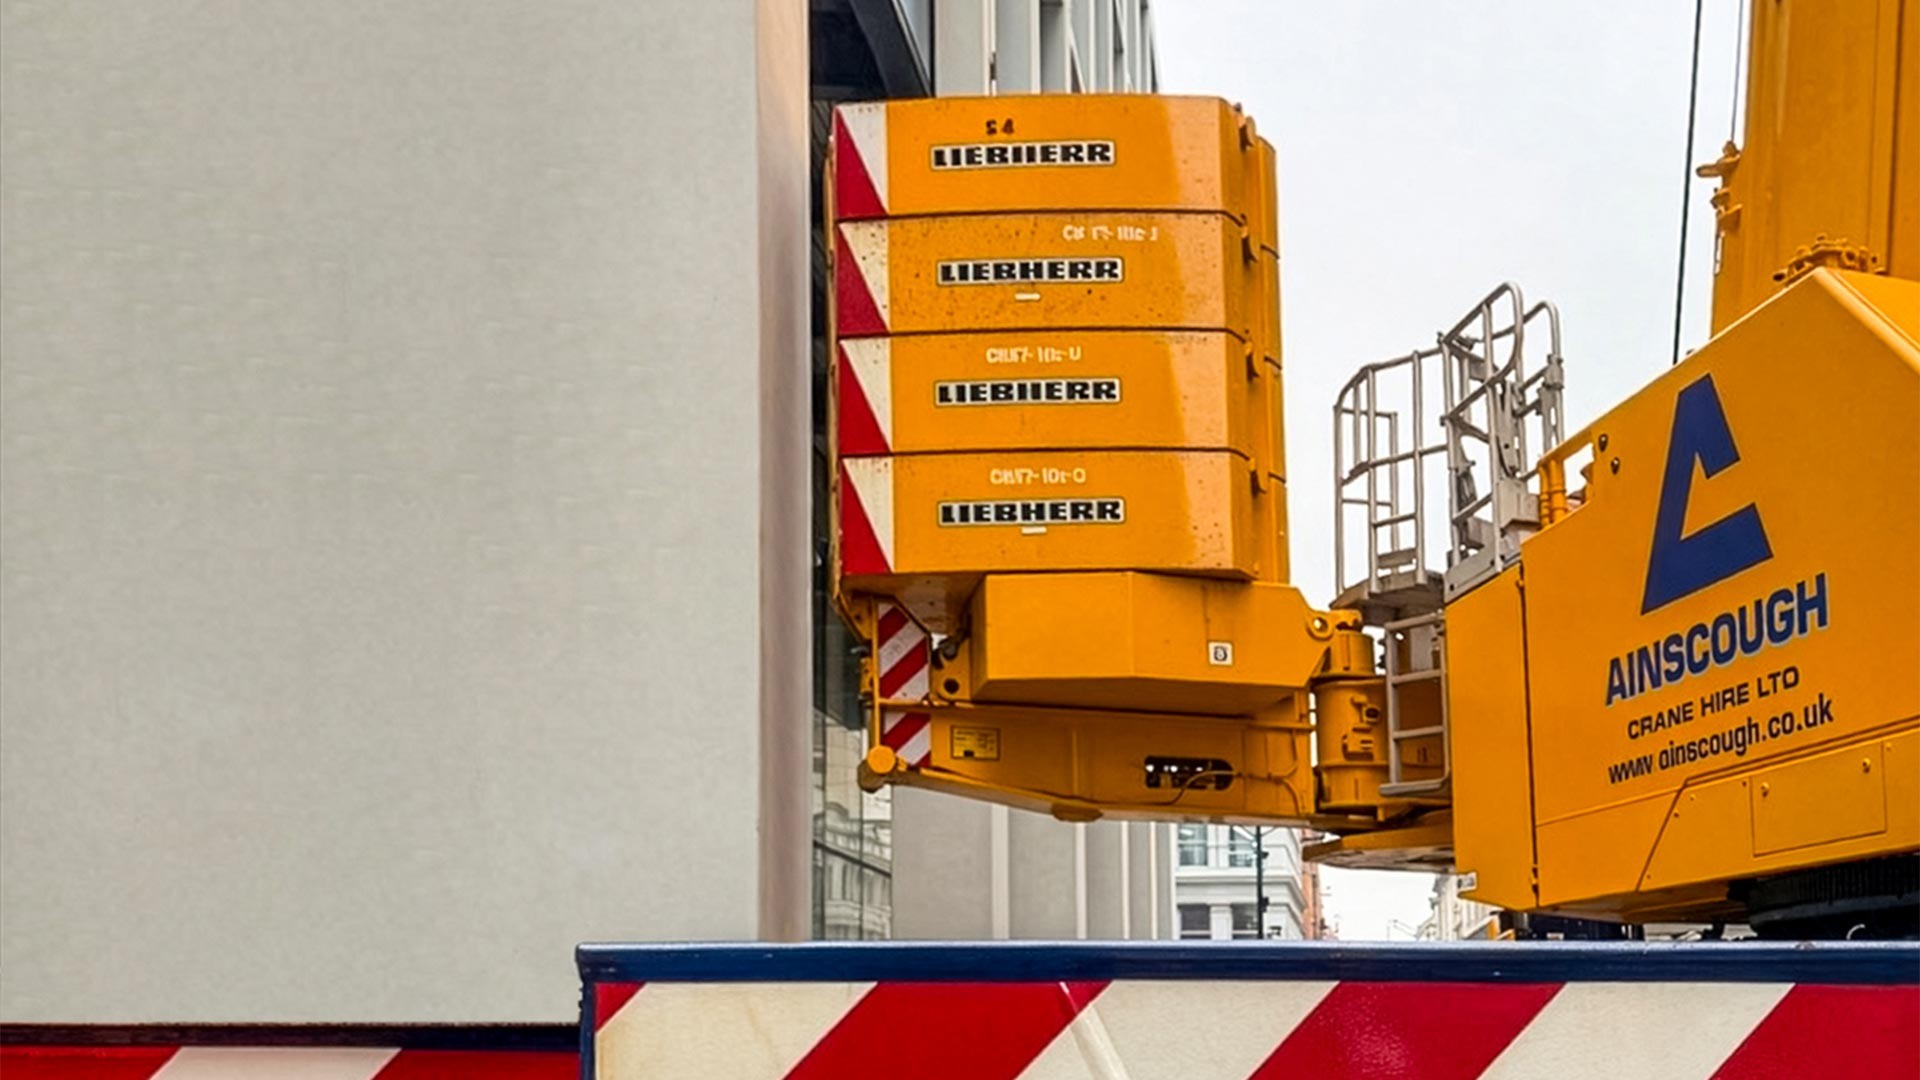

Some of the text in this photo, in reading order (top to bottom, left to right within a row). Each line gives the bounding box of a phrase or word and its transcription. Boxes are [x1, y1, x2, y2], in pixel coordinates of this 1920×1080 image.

[940, 260, 1119, 282] LIEBHERR
[941, 500, 1121, 523] LIEBHERR
[1605, 572, 1828, 707] AINSCOUGH
[1627, 665, 1800, 740] CRANE HIRE LTD
